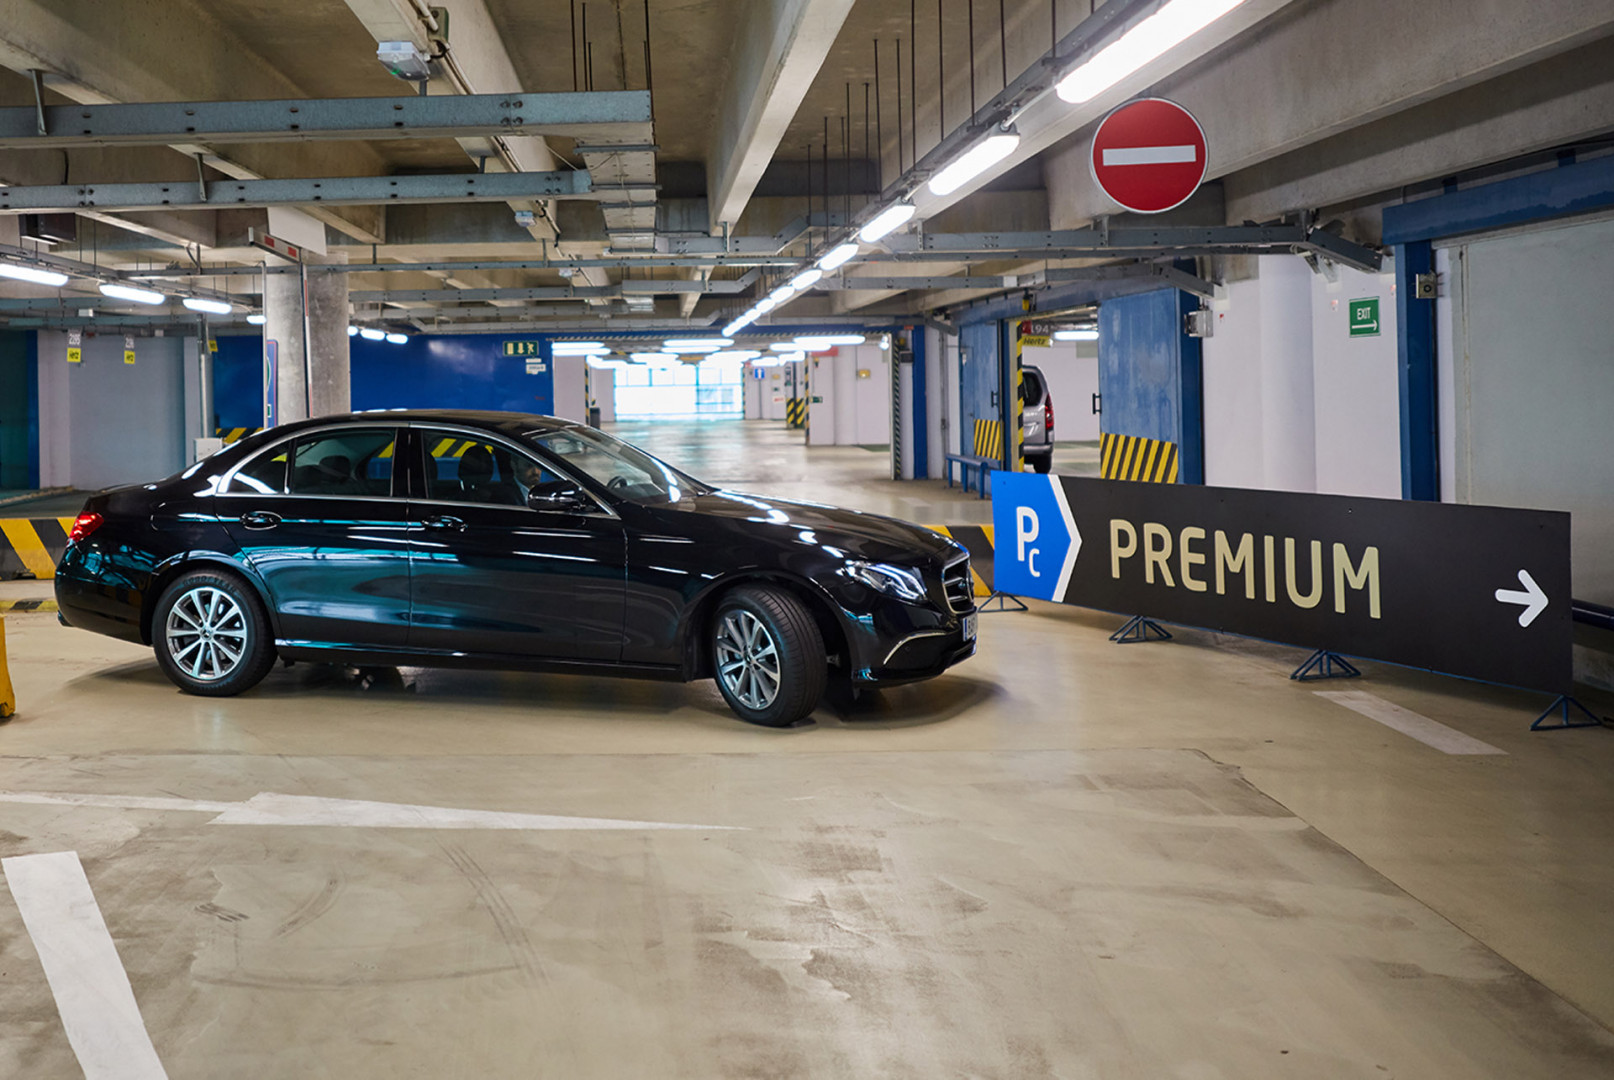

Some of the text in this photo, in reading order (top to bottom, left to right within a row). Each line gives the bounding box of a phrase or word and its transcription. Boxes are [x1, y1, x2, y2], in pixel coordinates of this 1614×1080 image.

[1357, 307, 1371, 320] EXIT
[1023, 337, 1045, 345] Hertz
[1109, 519, 1381, 619] PREMIUM
